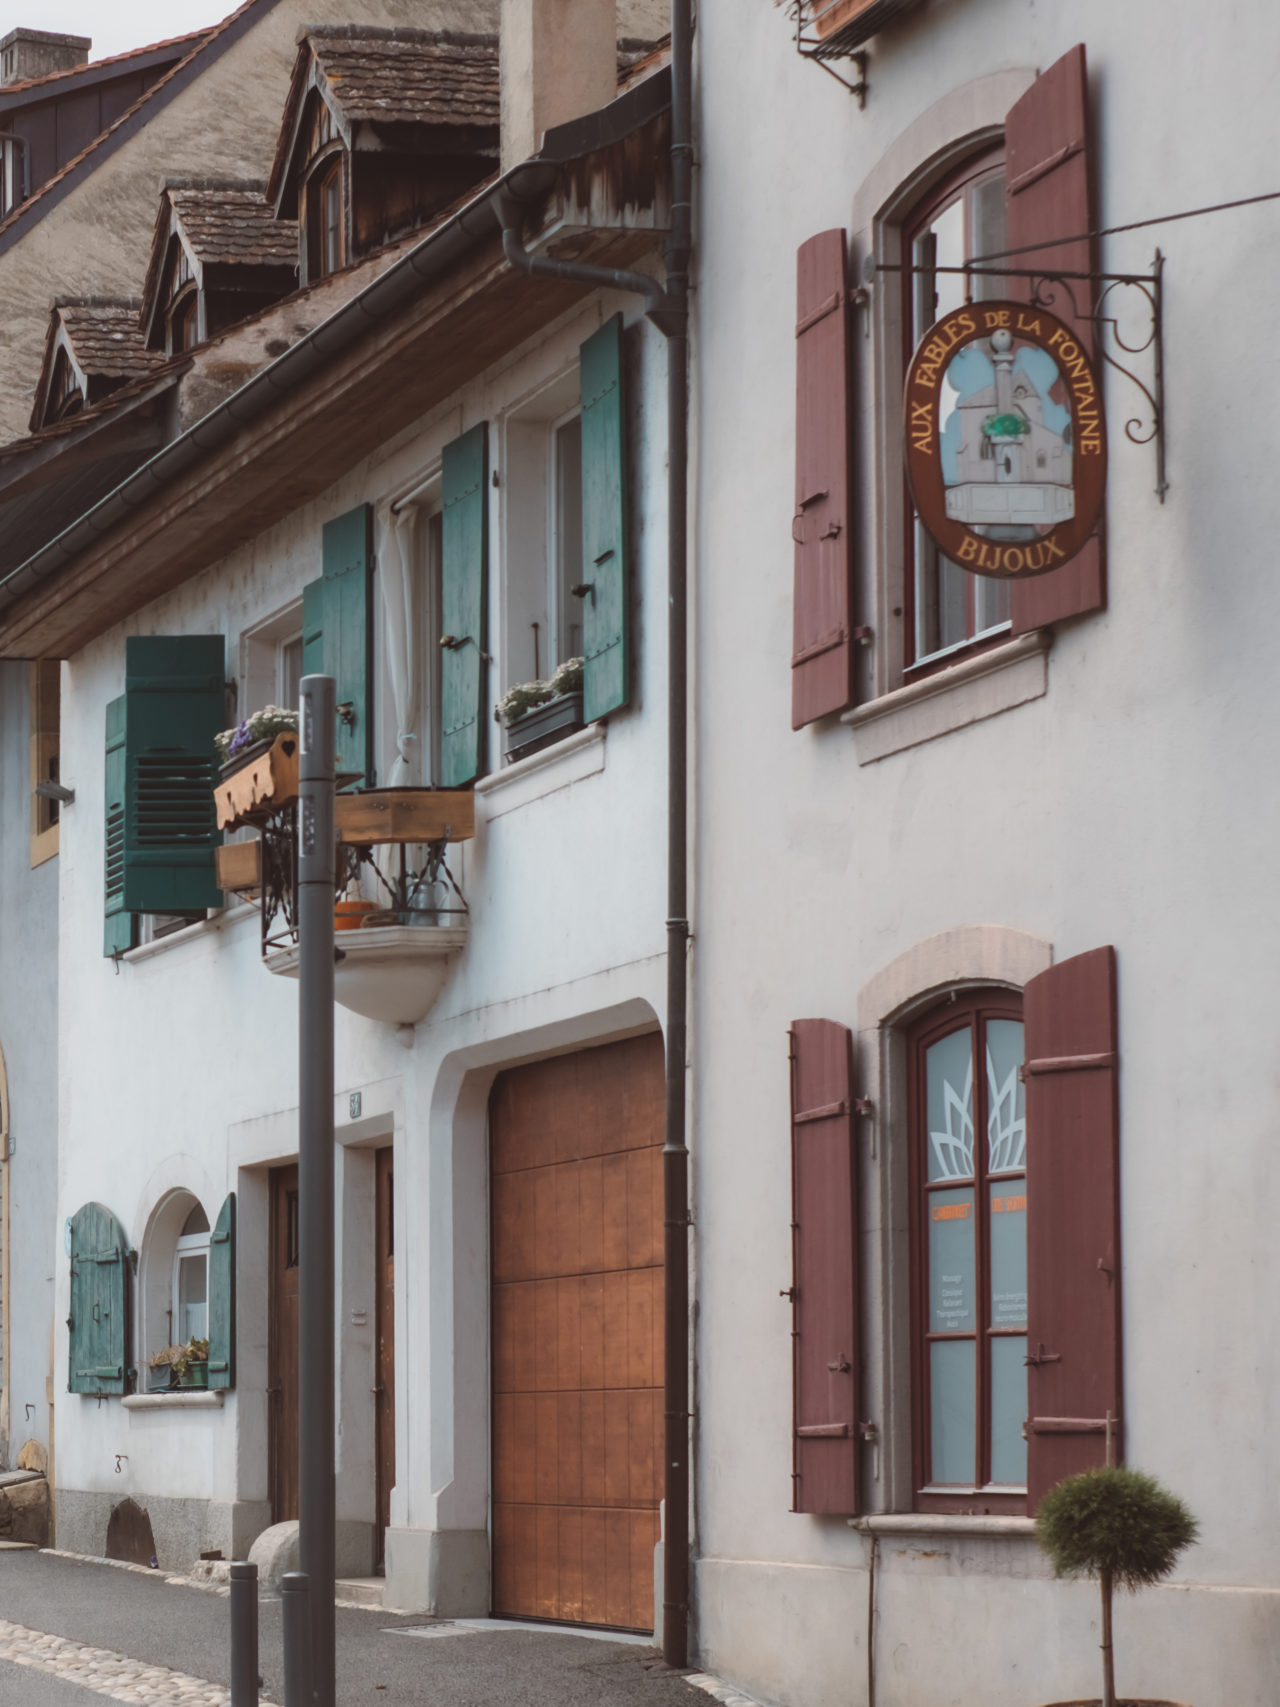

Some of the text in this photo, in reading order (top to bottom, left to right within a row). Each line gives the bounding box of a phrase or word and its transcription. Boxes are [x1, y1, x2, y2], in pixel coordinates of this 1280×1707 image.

[911, 310, 1101, 455] AUX FABLES DE LA FONTAINE
[956, 535, 1067, 572] BIJOUX
[932, 1203, 971, 1221] CABINET
